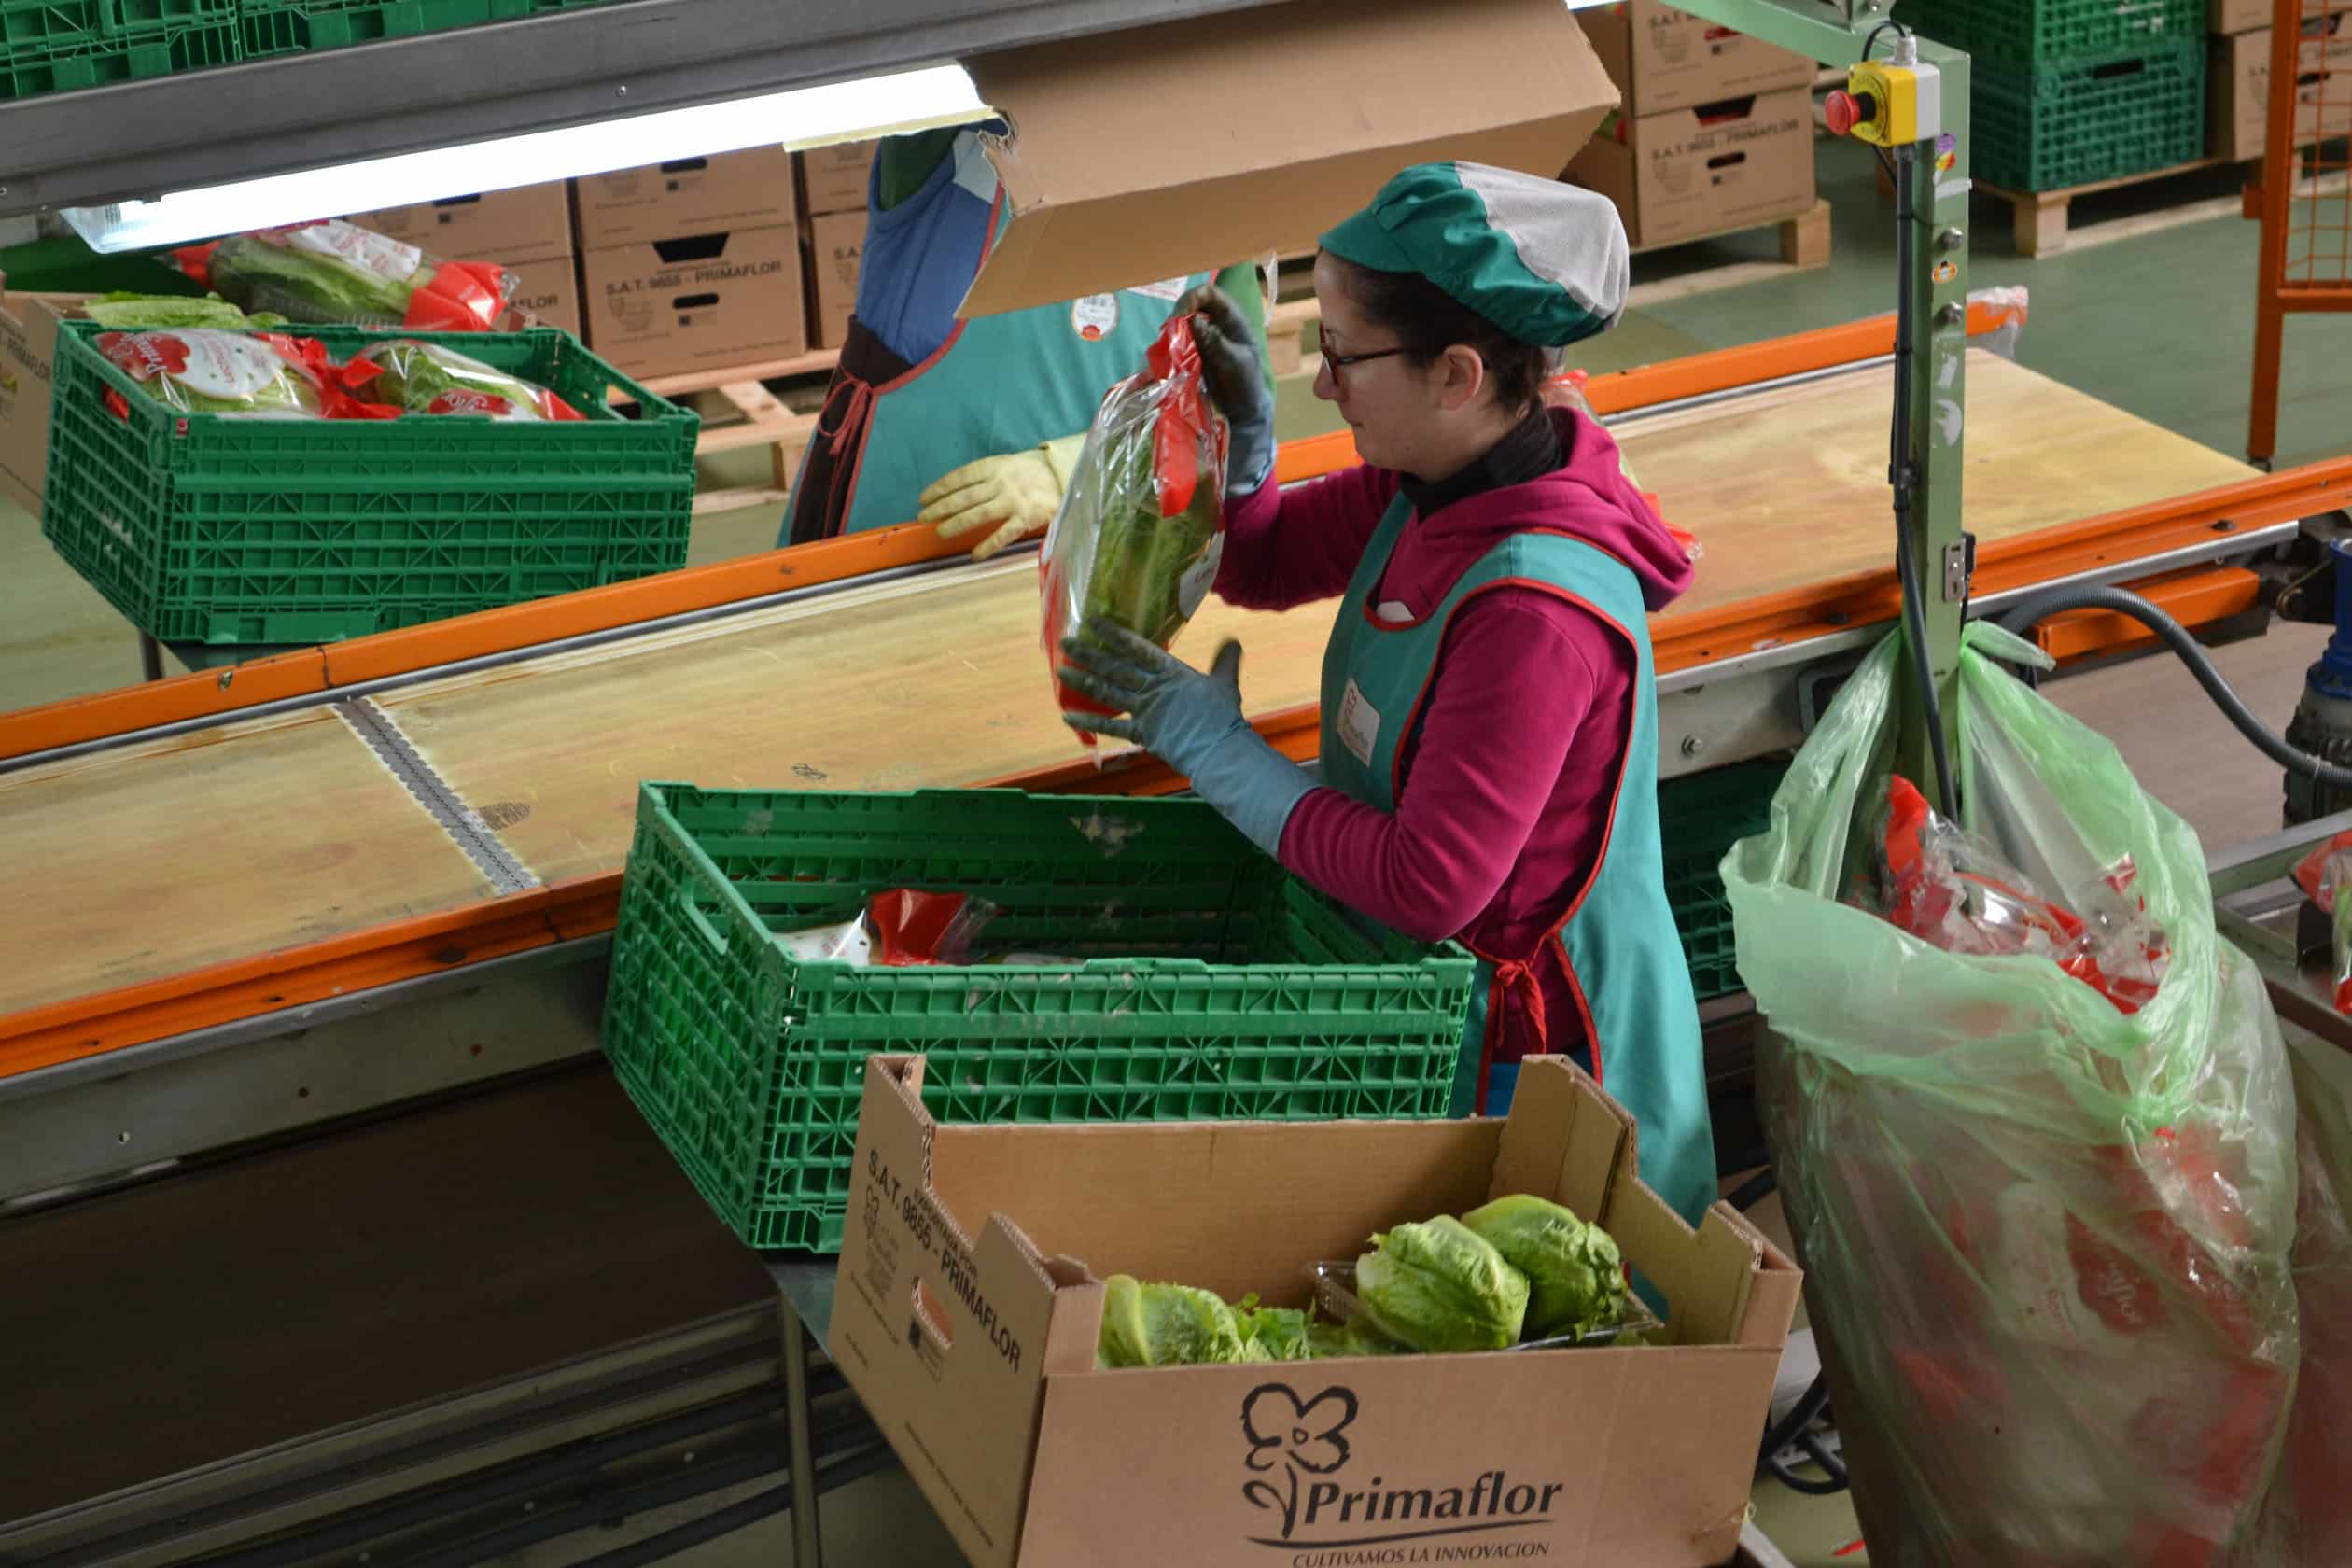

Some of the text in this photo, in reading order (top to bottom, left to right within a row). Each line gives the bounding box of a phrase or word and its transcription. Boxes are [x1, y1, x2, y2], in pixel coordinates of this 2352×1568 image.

[694, 260, 782, 283] PRIMAFLOR
[868, 1149, 902, 1211] S.A.T.
[903, 1196, 931, 1250] 9855
[941, 1252, 1022, 1374] PRIMAFLOR
[1304, 1470, 1563, 1524] Primaflor
[1293, 1540, 1550, 1568] CULTIVAMOS LA INNOVACION
